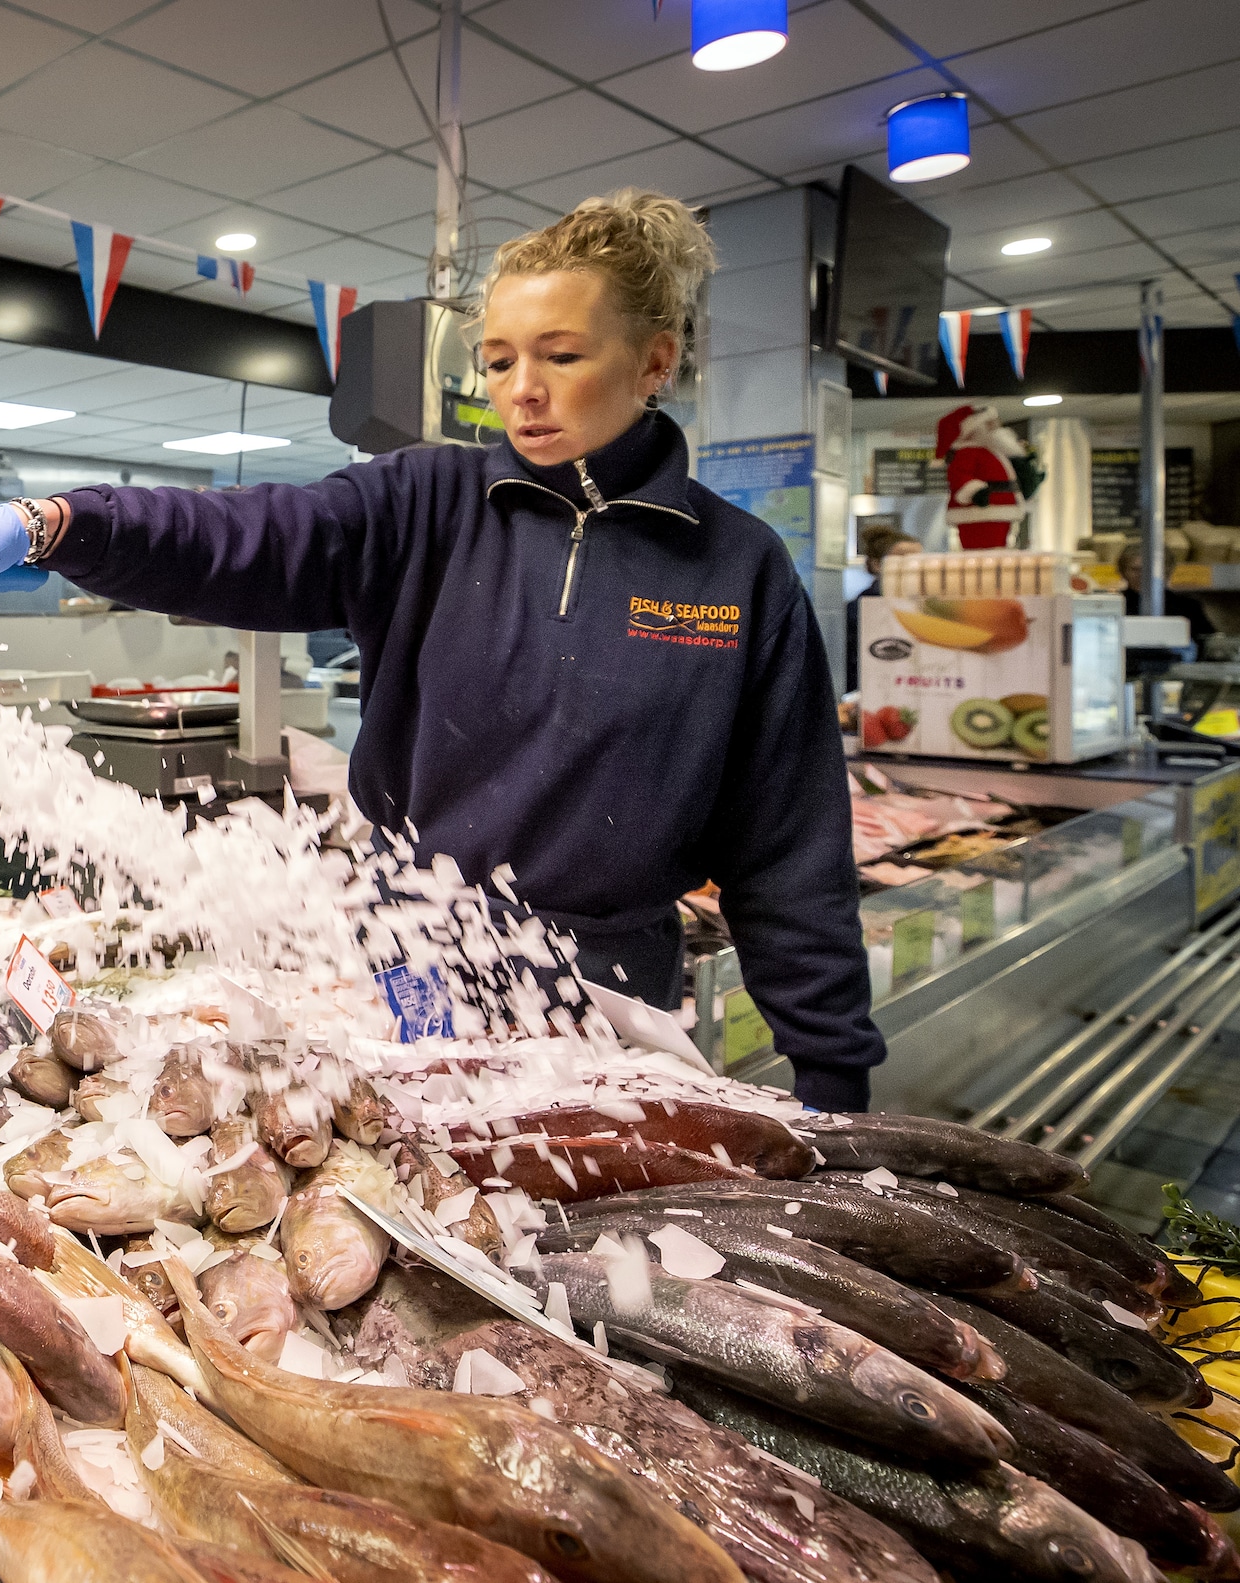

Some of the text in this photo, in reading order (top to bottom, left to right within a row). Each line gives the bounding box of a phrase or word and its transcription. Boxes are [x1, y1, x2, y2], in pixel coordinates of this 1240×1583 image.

[629, 595, 741, 621] FISH & SEAFOOD
[627, 628, 739, 649] www.waasdorp.nl
[696, 621, 739, 635] Waasdorp
